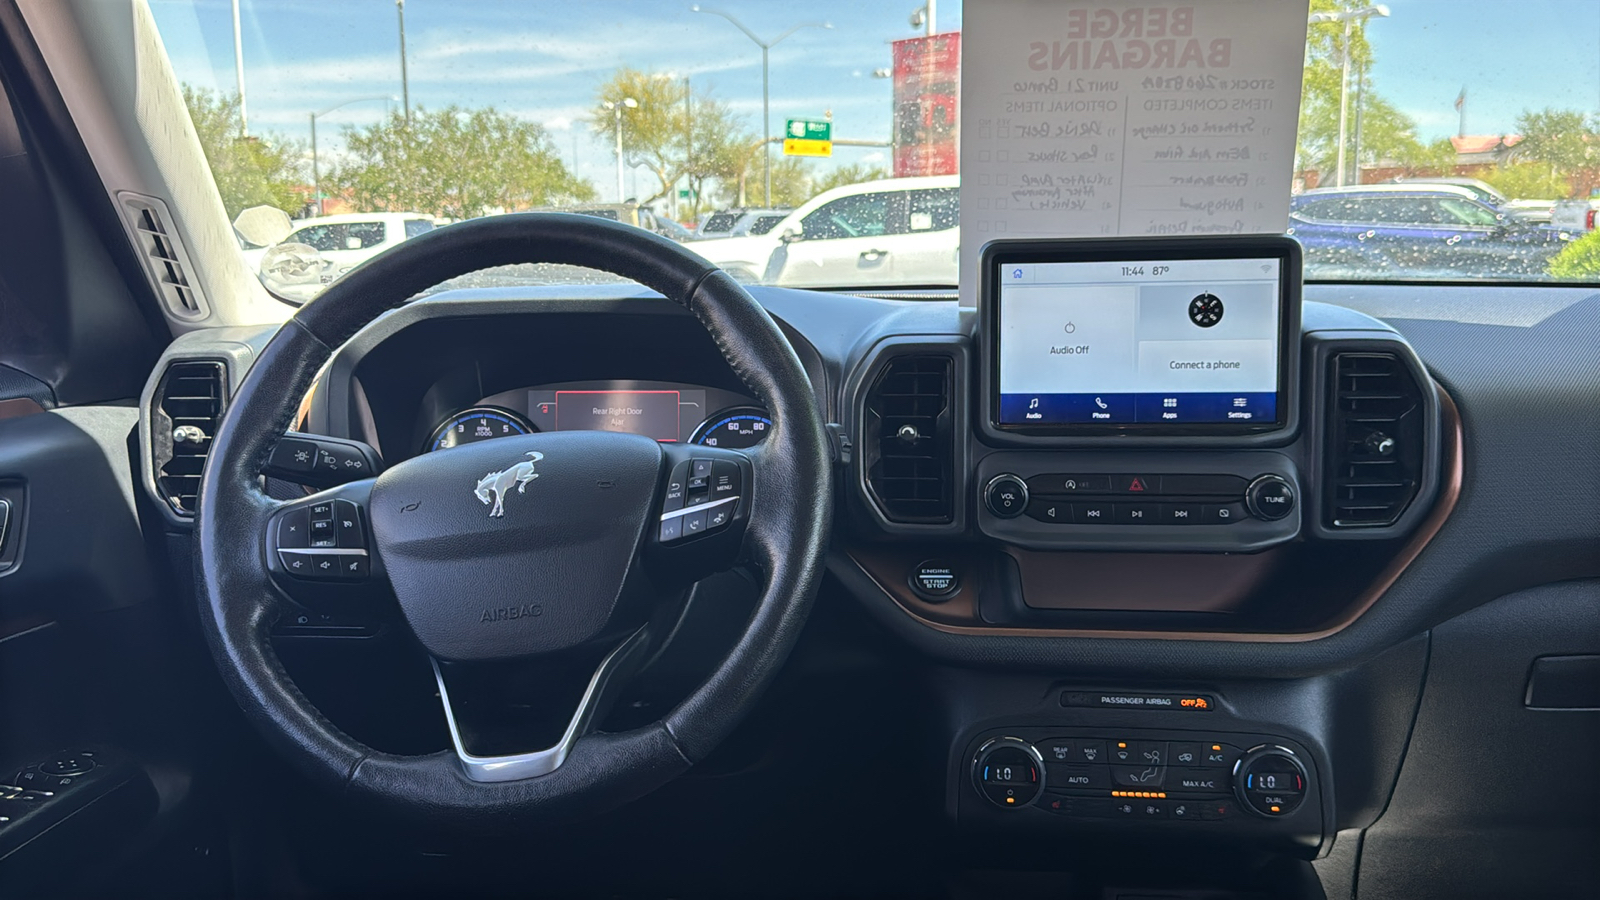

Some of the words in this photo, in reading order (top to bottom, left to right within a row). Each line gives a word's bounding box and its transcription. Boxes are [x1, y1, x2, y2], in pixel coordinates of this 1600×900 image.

[1121, 266, 1144, 277] 11:44
[1050, 345, 1074, 355] Audio
[1075, 345, 1089, 354] Off
[1169, 360, 1205, 370] Connect
[1213, 361, 1240, 371] phone
[592, 407, 607, 415] Rear
[609, 407, 625, 416] Right
[627, 407, 643, 415] Door
[1162, 412, 1178, 420] Apps
[1228, 411, 1252, 420] Settings
[480, 418, 487, 427] 4
[610, 418, 624, 427] Ajar
[727, 422, 739, 431] 60
[753, 423, 764, 431] 80
[458, 424, 465, 433] 3
[502, 425, 509, 433] 5
[706, 438, 717, 446] 40
[668, 491, 682, 499] BACK
[1264, 496, 1286, 504] TUNE
[480, 603, 543, 623] AIRBAG
[1101, 696, 1144, 705] PASSENGER
[1145, 697, 1172, 705] AIRBAG
[1180, 699, 1196, 707] OFF
[1068, 776, 1089, 784] AUTO
[1182, 780, 1199, 788] MAX
[1265, 796, 1284, 804] DUAL
